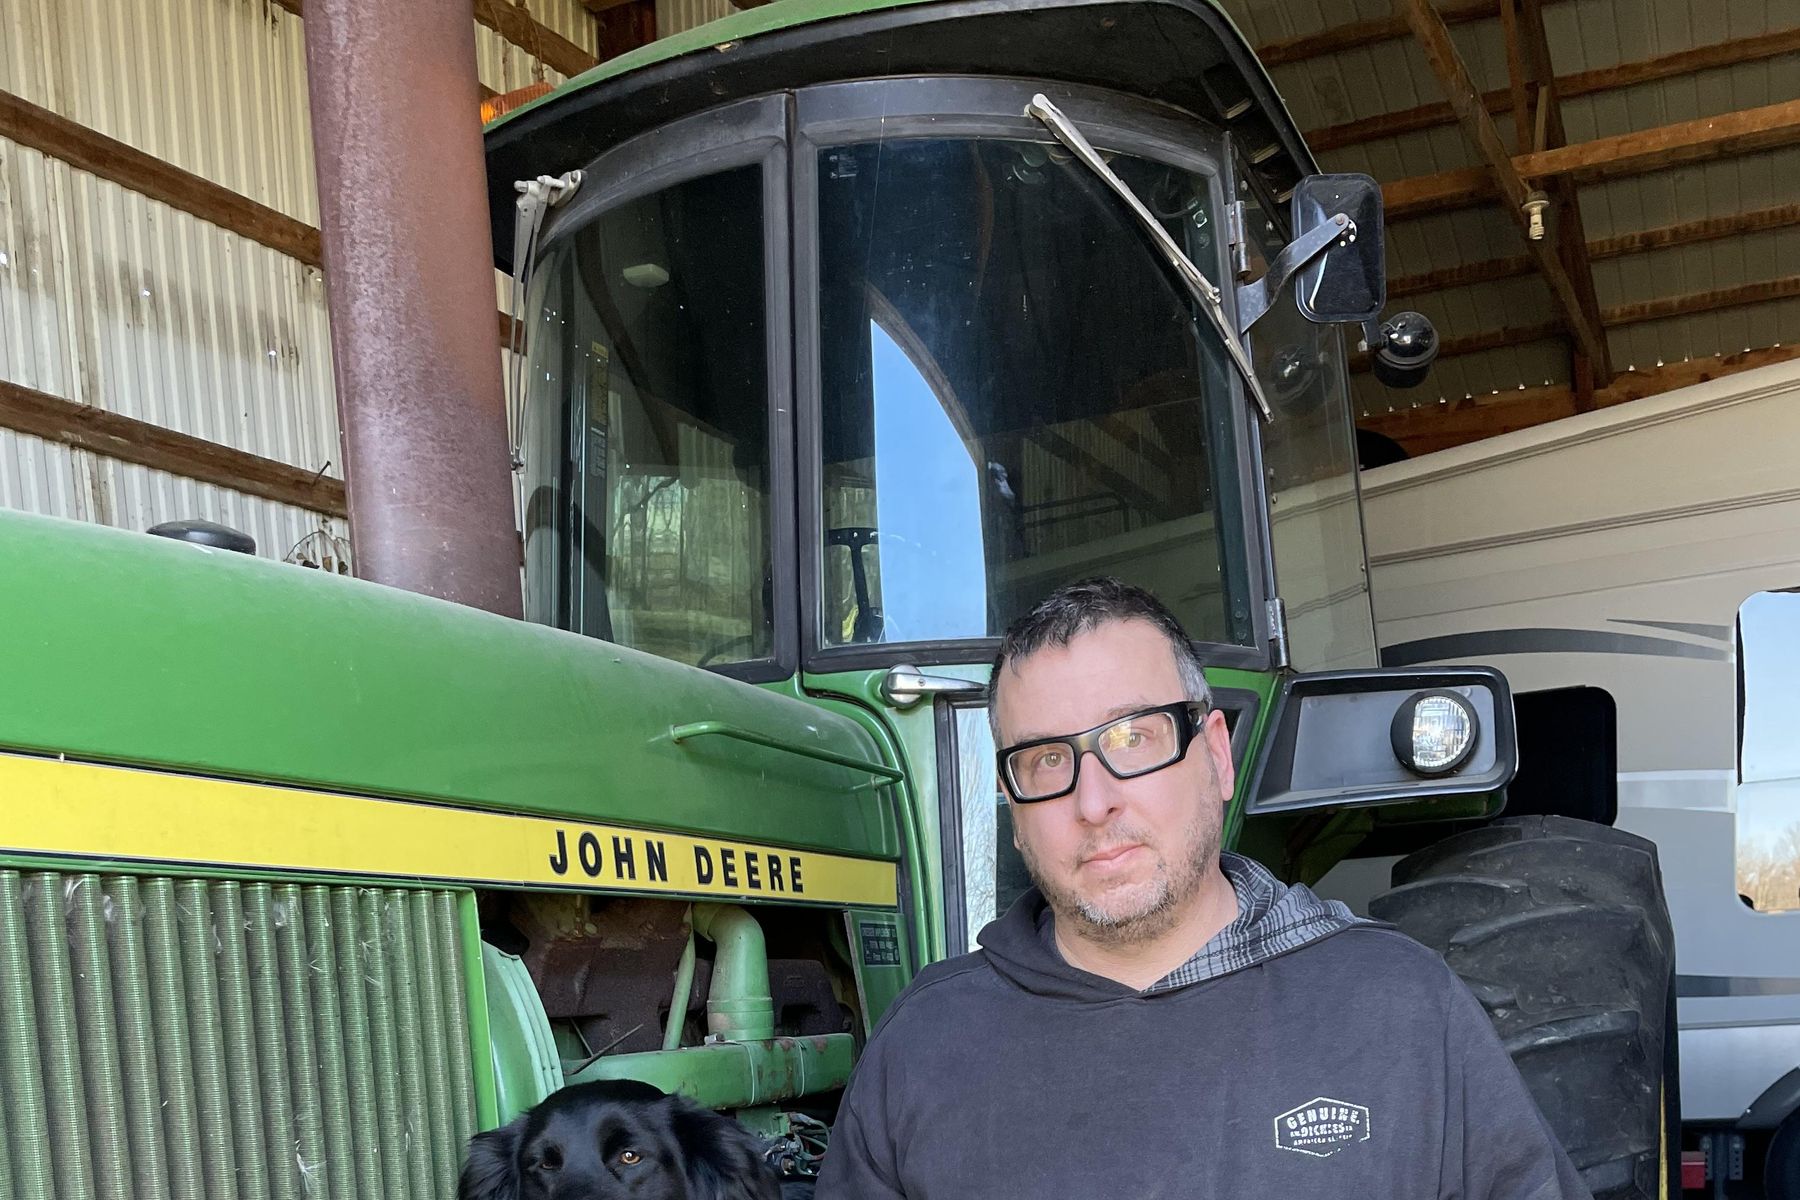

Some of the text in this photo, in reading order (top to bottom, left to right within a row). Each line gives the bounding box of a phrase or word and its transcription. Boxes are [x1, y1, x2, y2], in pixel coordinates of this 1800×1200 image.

[549, 829, 804, 893] JOHN DEERE
[1286, 1107, 1360, 1130] GENUINE
